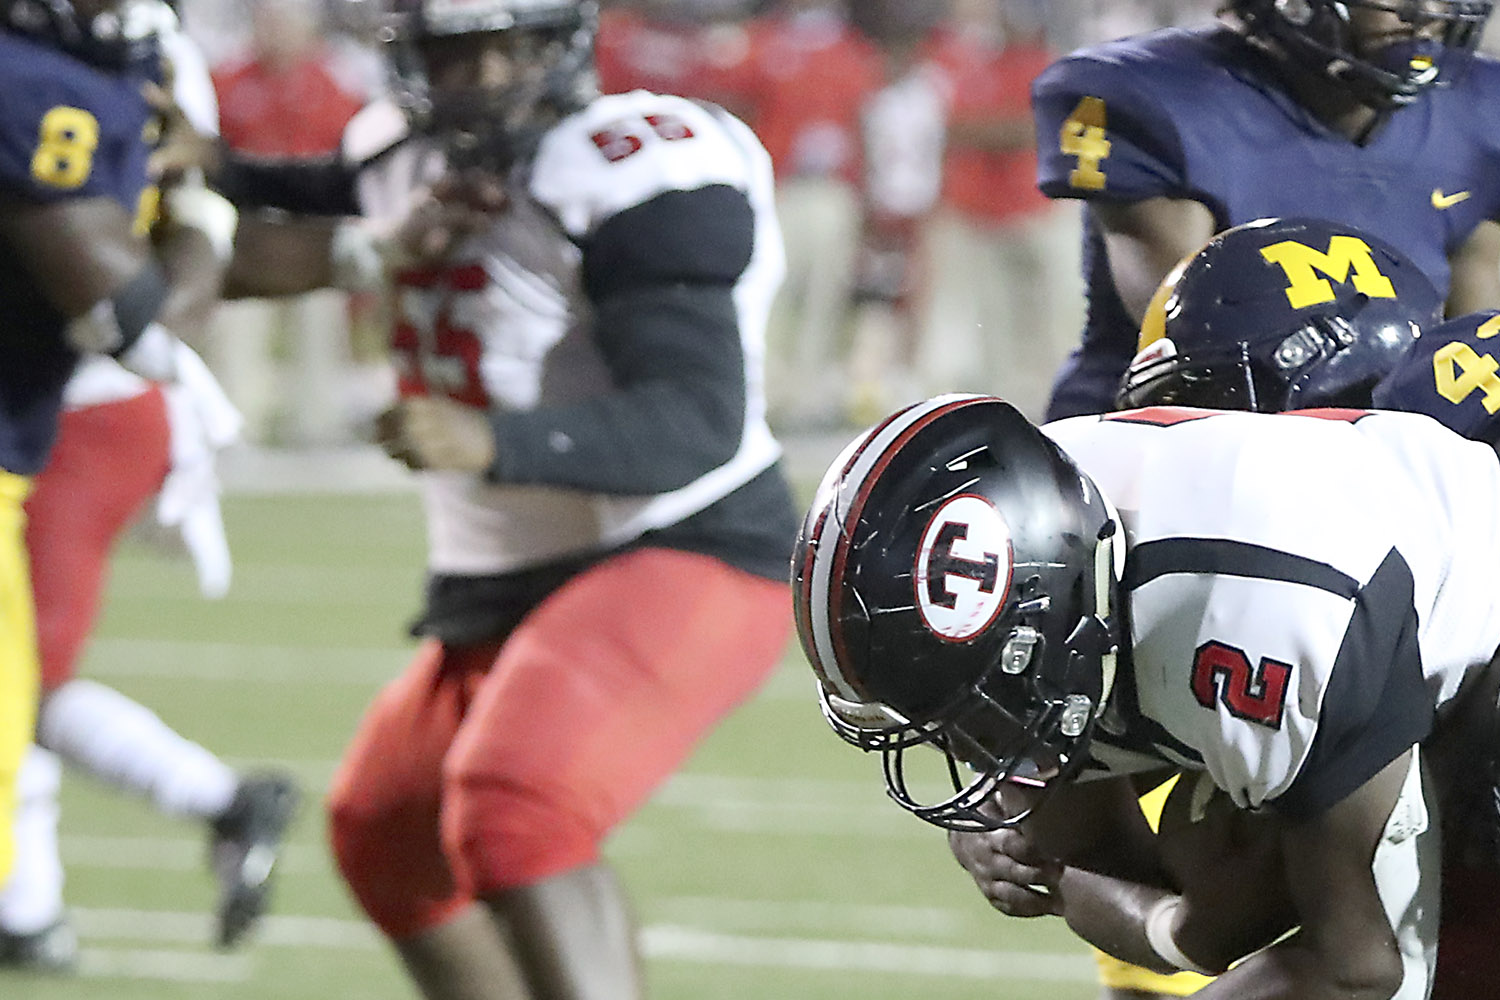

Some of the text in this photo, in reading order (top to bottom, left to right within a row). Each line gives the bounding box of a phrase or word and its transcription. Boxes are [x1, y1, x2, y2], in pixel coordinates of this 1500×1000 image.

[31, 106, 98, 189] 8
[1060, 96, 1111, 190] 4
[1259, 235, 1396, 309] M
[926, 520, 999, 610] T
[1189, 639, 1293, 731] 2
